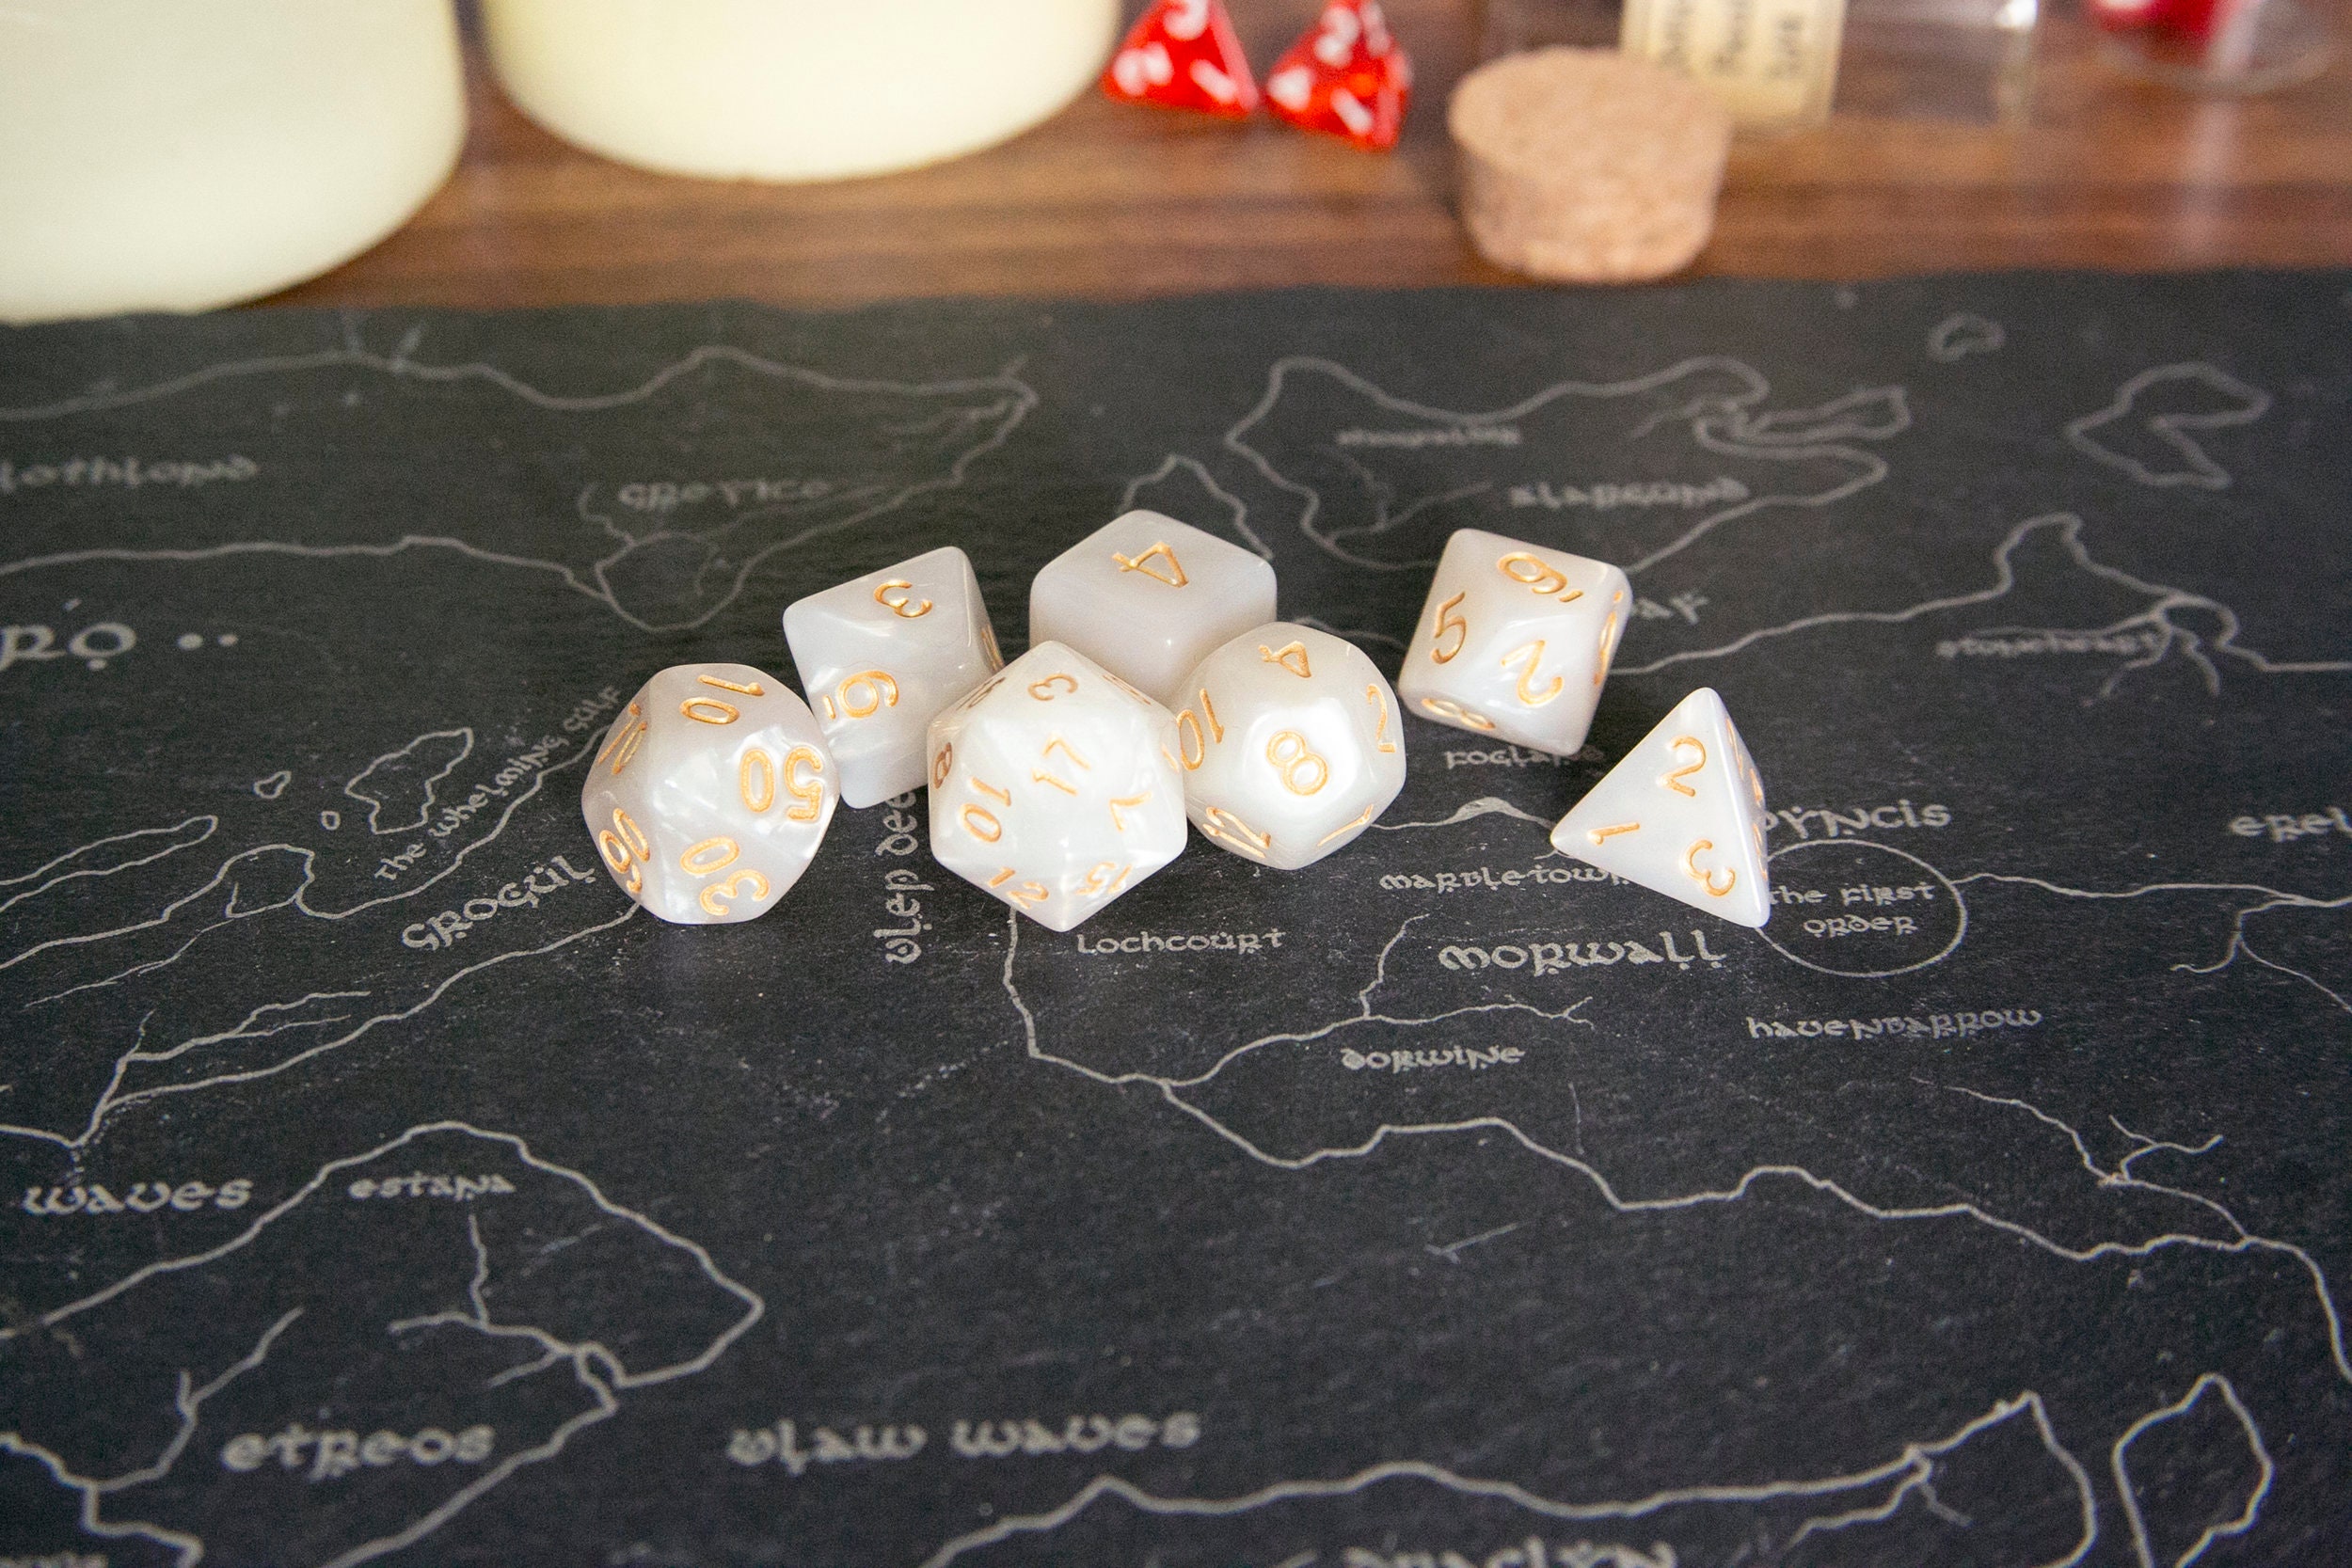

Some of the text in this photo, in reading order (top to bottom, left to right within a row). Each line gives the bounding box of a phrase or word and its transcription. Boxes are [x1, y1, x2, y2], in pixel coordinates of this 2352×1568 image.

[1112, 541, 1189, 589] 4
[873, 579, 933, 619] 3
[1431, 591, 1468, 665] 5
[1027, 673, 1078, 702] 3
[1258, 641, 1311, 678] 4
[1502, 640, 1564, 707] 2
[1176, 688, 1224, 771] 10
[1367, 683, 1396, 753] 2
[739, 747, 823, 821] 50
[1032, 731, 1091, 797] 17
[1265, 729, 1329, 797] 8
[1659, 735, 1707, 798] 2
[958, 776, 1012, 843] 10
[1587, 822, 1641, 846] 1
[679, 836, 770, 917] 30
[1681, 839, 1737, 897] 3
